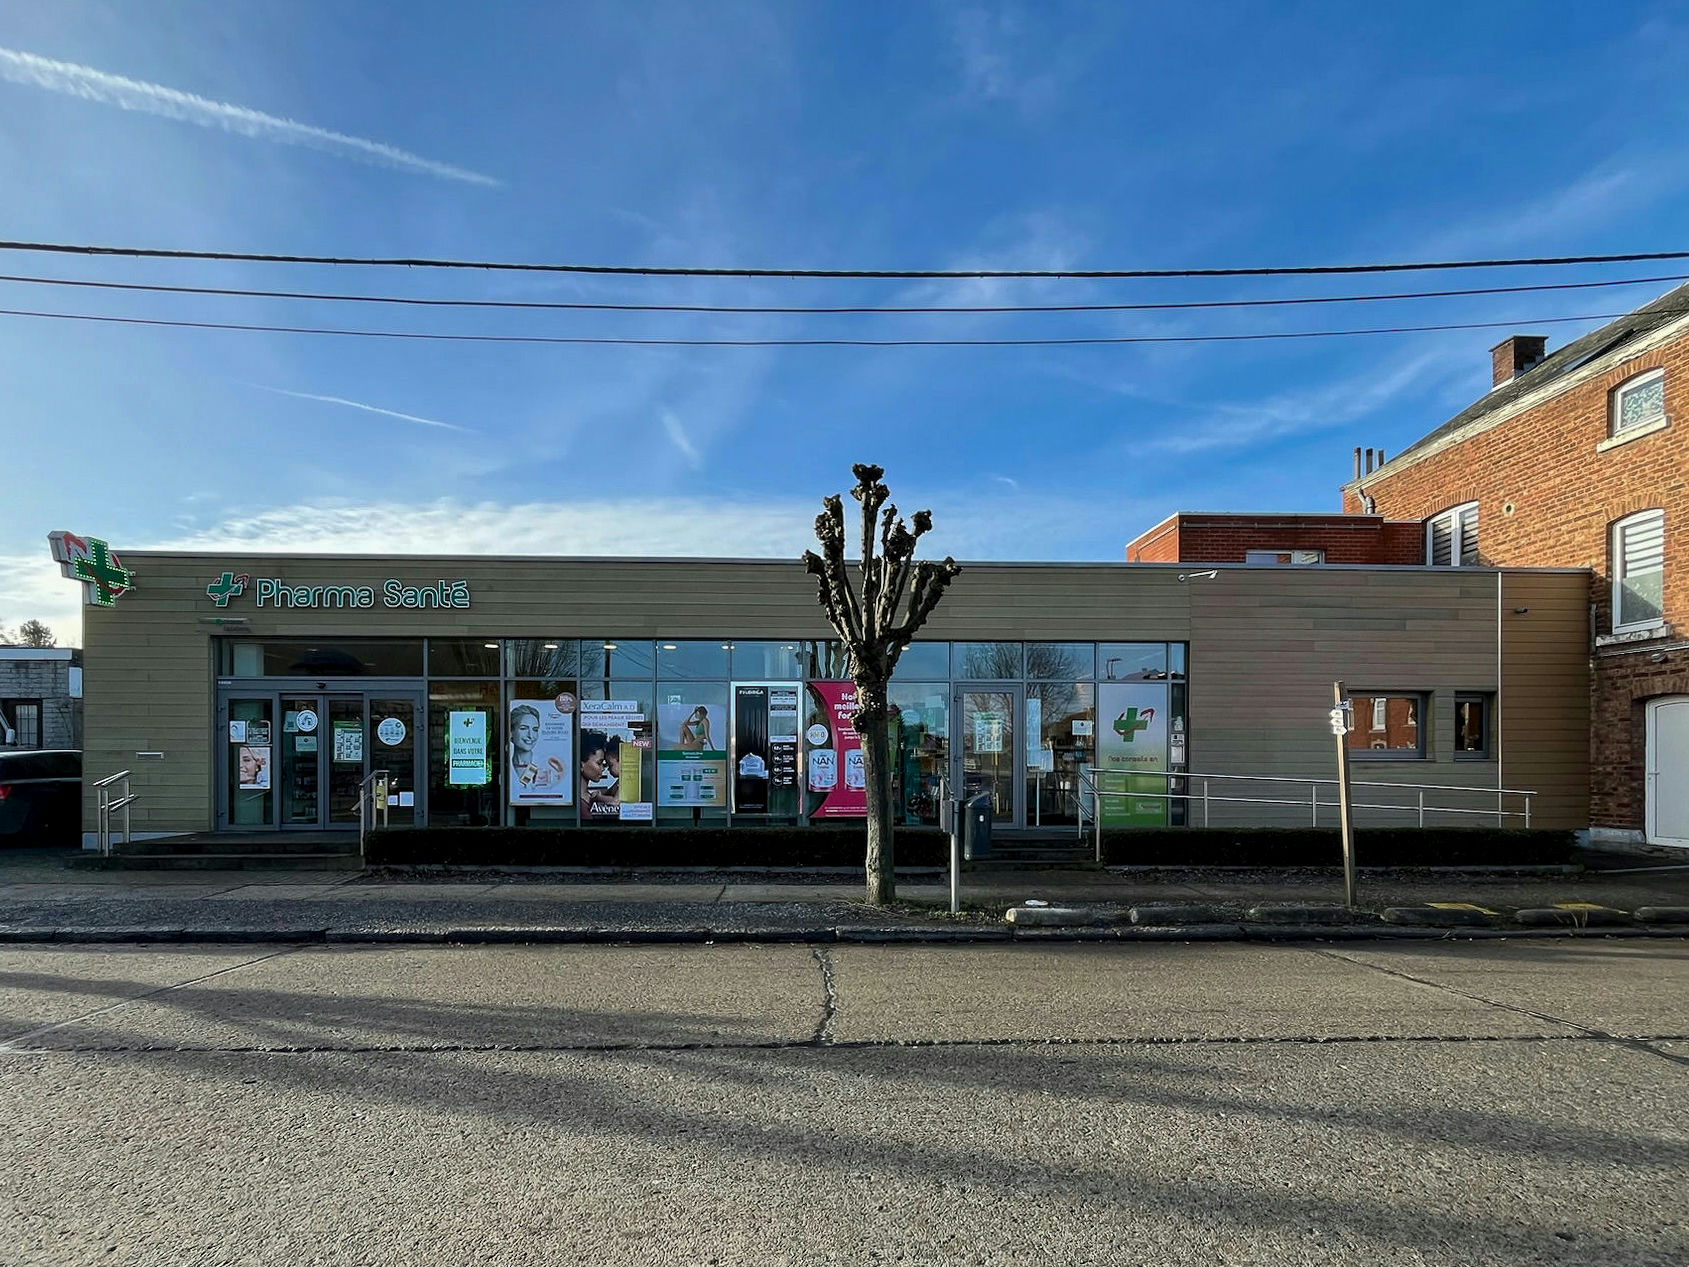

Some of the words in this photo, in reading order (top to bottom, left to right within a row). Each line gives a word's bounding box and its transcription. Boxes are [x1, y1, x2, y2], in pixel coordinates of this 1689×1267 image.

[256, 578, 375, 608] Pharma
[383, 578, 471, 608] Santé
[583, 702, 622, 711] XeraCalm
[812, 757, 834, 765] NAN
[849, 757, 864, 765] NA
